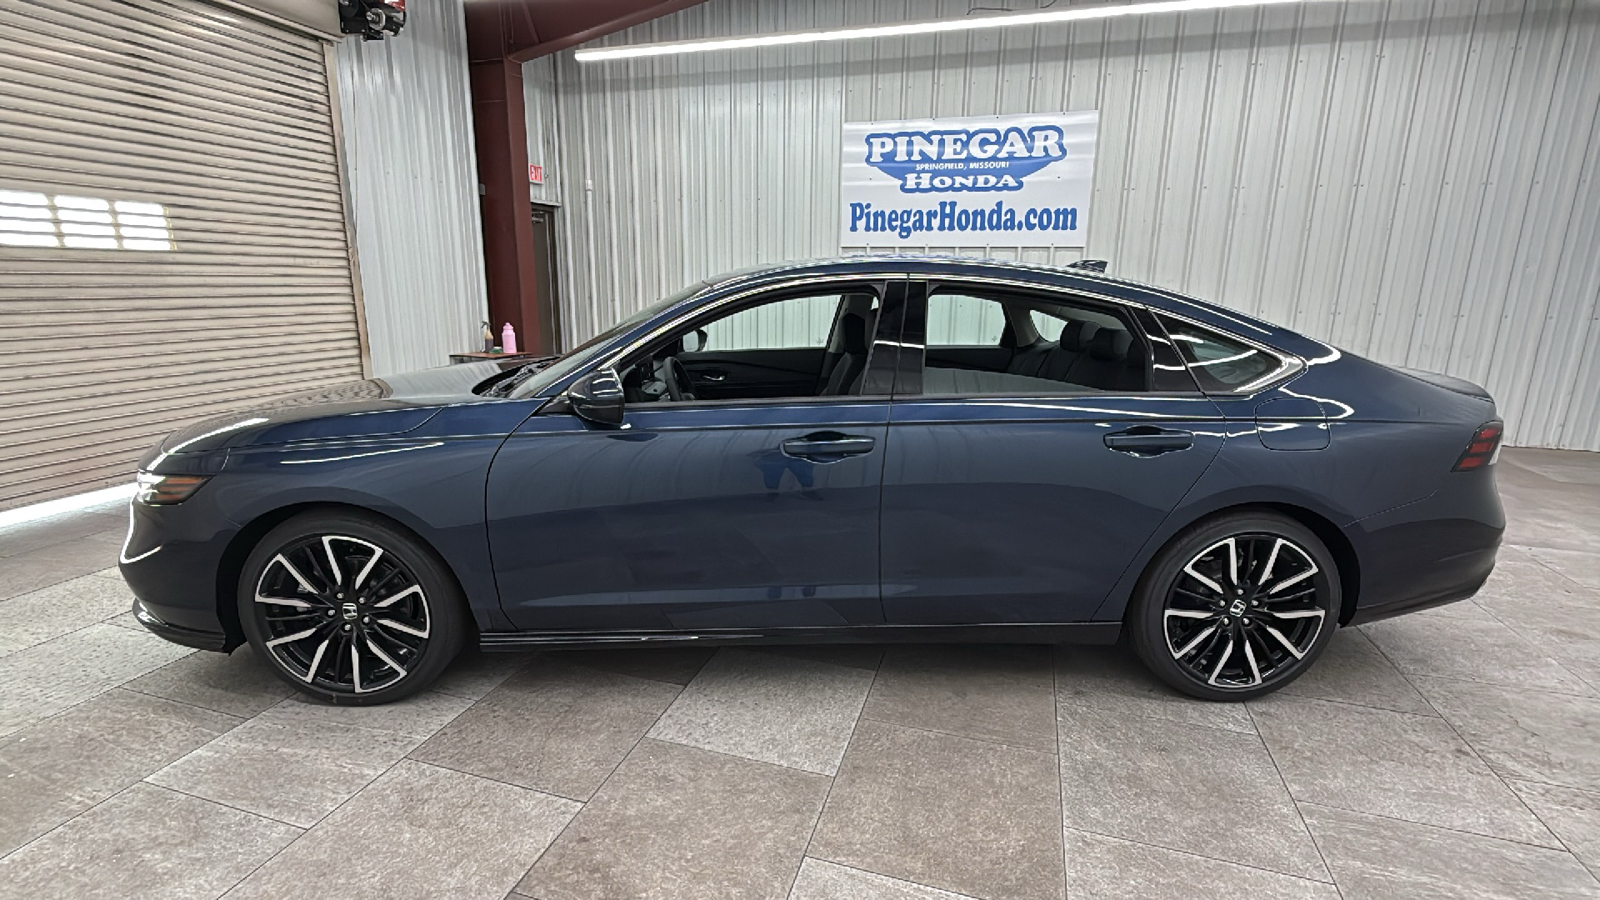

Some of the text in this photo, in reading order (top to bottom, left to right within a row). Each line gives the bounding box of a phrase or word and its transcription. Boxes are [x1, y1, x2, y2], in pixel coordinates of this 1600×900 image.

[868, 129, 1063, 163] PINEGAR
[529, 164, 542, 182] EXIT
[915, 161, 1010, 171] SPRINGFIELD, MISSOURI
[904, 172, 1019, 189] HONDA
[849, 200, 1078, 239] PinegarHonda.com
